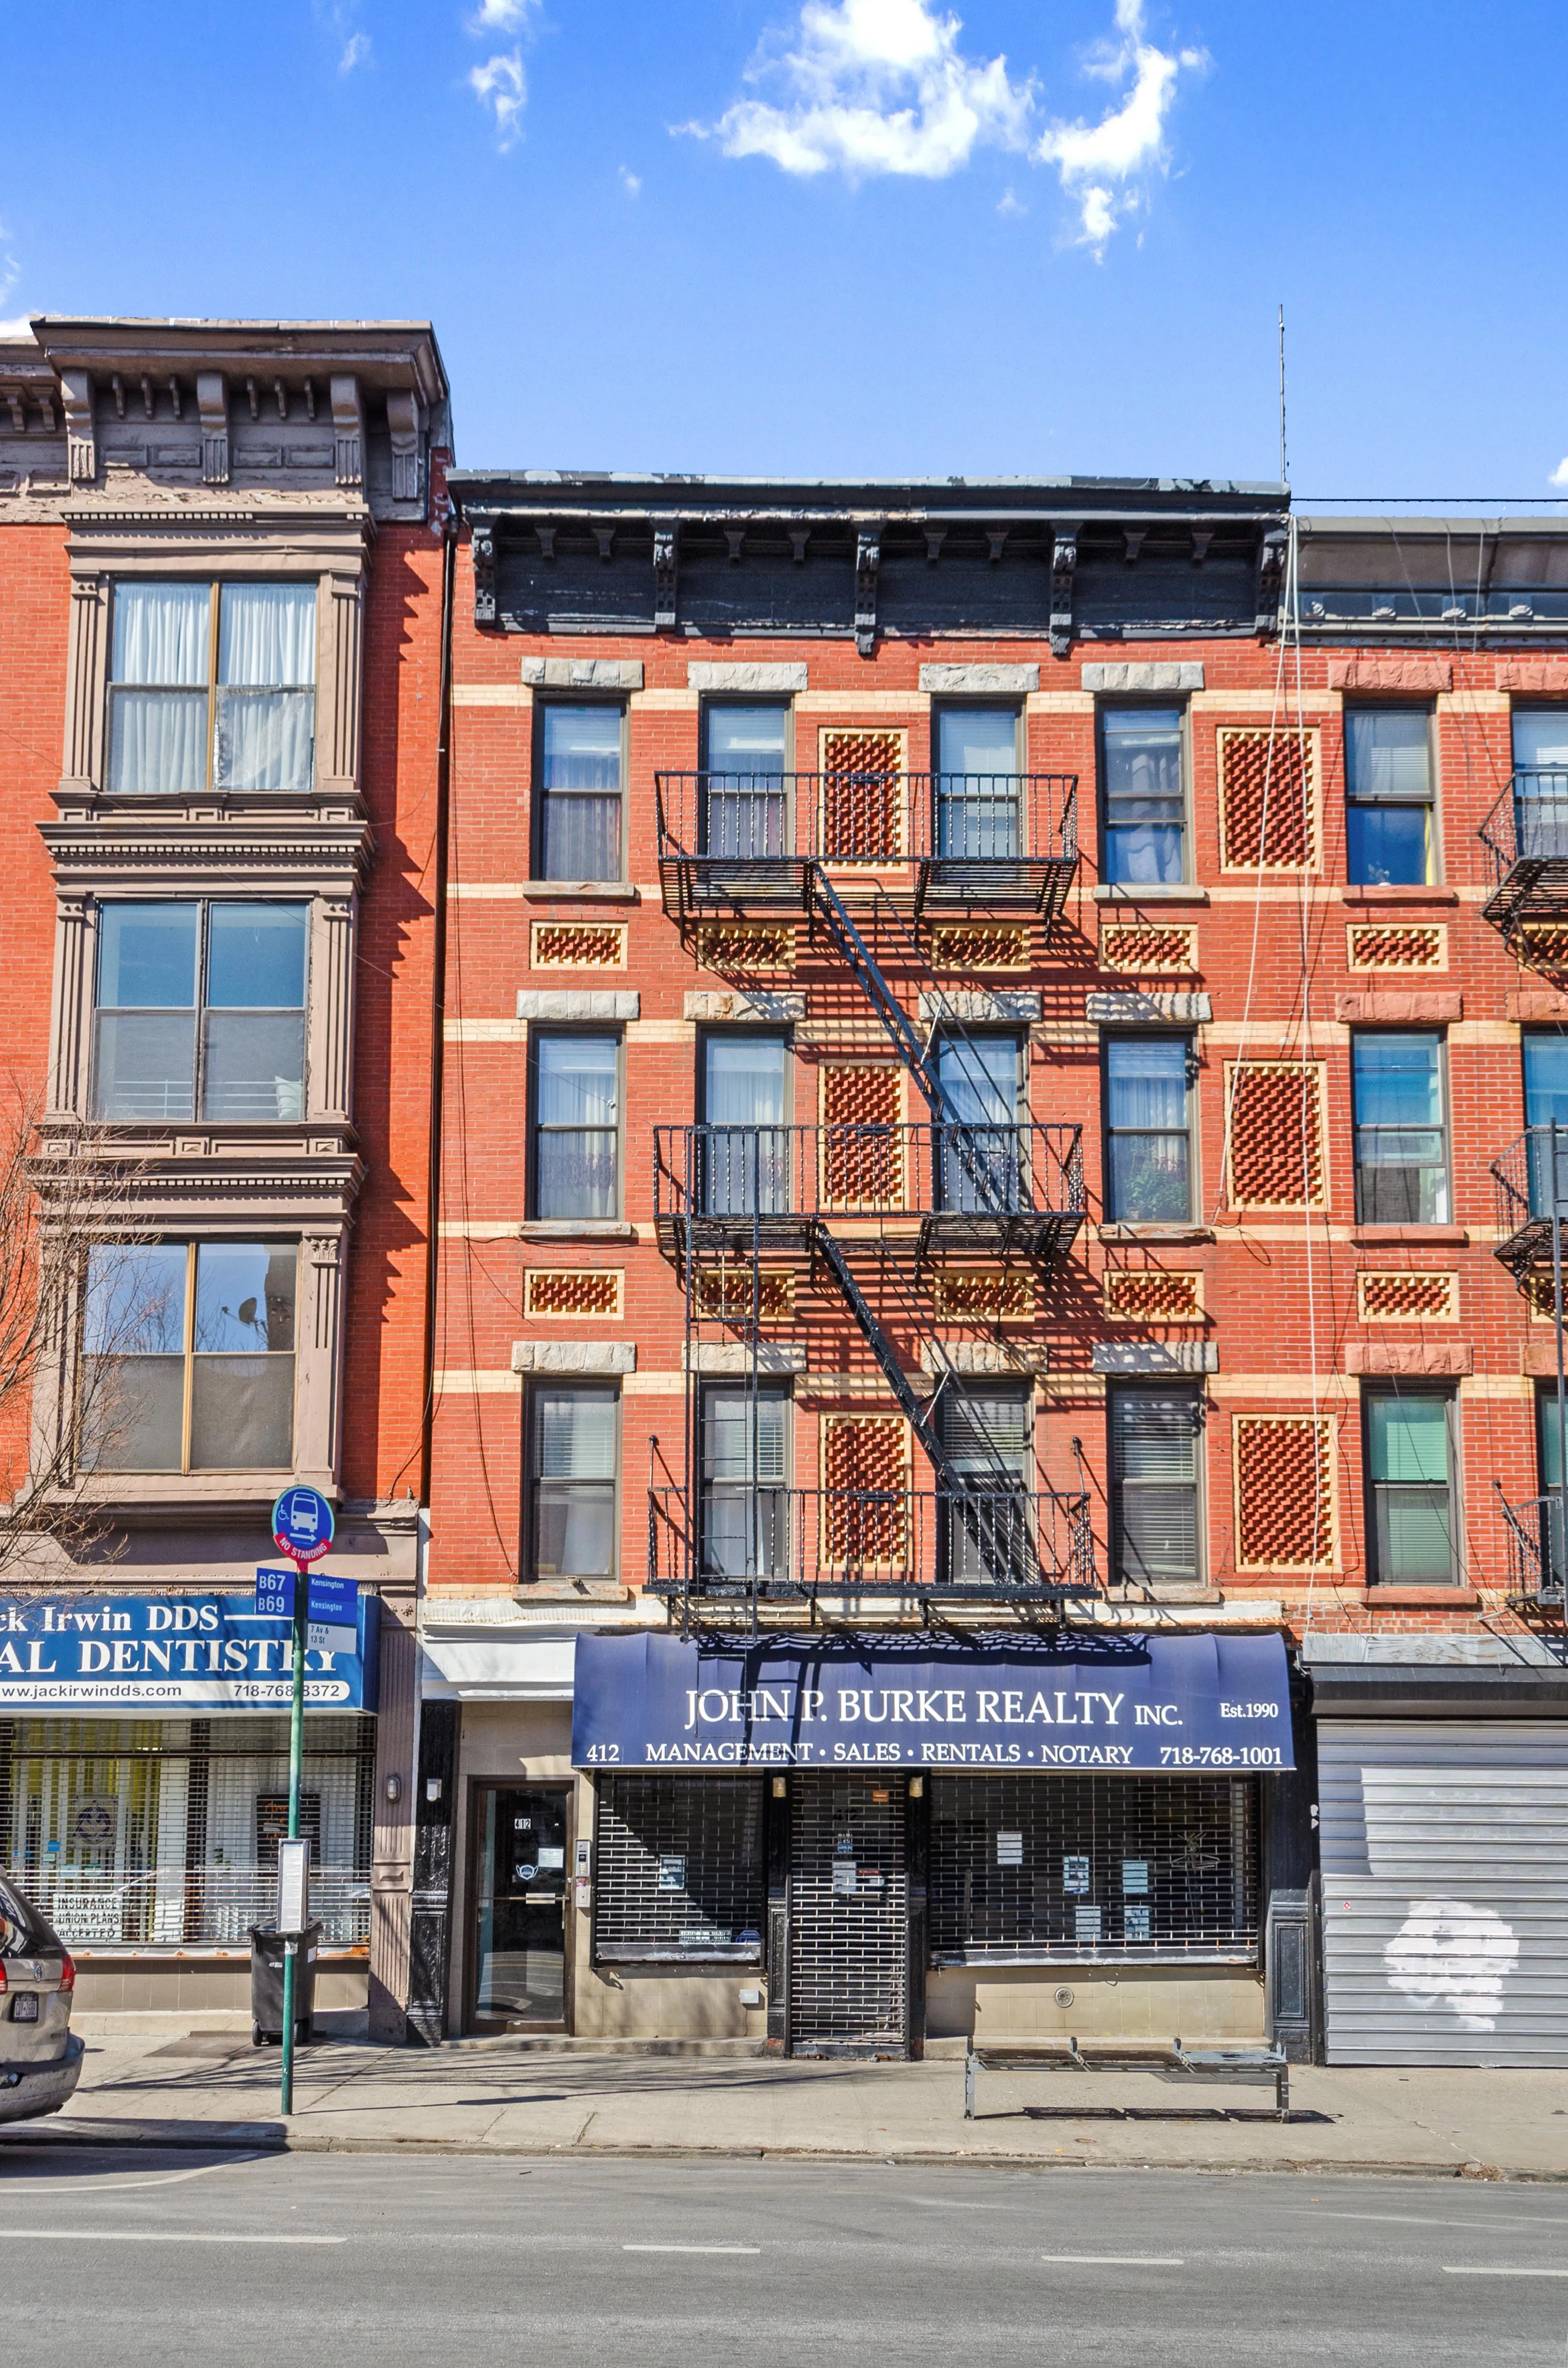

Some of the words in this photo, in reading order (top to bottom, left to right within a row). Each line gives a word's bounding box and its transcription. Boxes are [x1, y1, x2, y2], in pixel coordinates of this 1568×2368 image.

[280, 1537, 290, 1550] NO
[291, 1543, 327, 1560] STANDING
[259, 1574, 285, 1591] B67
[311, 1578, 344, 1589] Kensington
[258, 1595, 284, 1613] B69
[311, 1600, 342, 1611] Kensington
[41, 1606, 132, 1631] Irwin
[146, 1605, 219, 1630] DDS
[319, 1636, 325, 1644] St
[0, 1640, 57, 1673] AL
[77, 1640, 337, 1672] DENTISTRY
[233, 1685, 339, 1697] 718-7688372
[685, 1689, 791, 1730] JOHN
[801, 1690, 827, 1722] P.
[837, 1690, 967, 1723] BURKE
[976, 1690, 1125, 1725] REALTY
[1134, 1704, 1183, 1726] INC.
[1220, 1702, 1278, 1718] Est.1990
[587, 1744, 620, 1762] 412
[645, 1742, 813, 1761] MANAGEMENT
[833, 1742, 901, 1761] SALES
[921, 1743, 1021, 1763] RENTALS
[1041, 1745, 1134, 1764] NOTARY
[1160, 1746, 1283, 1765] 718-768-1001
[515, 1819, 530, 1829] 412
[58, 1897, 117, 1910] INSURANCE
[59, 1912, 87, 1924] UNION
[90, 1912, 119, 1924] PLANS
